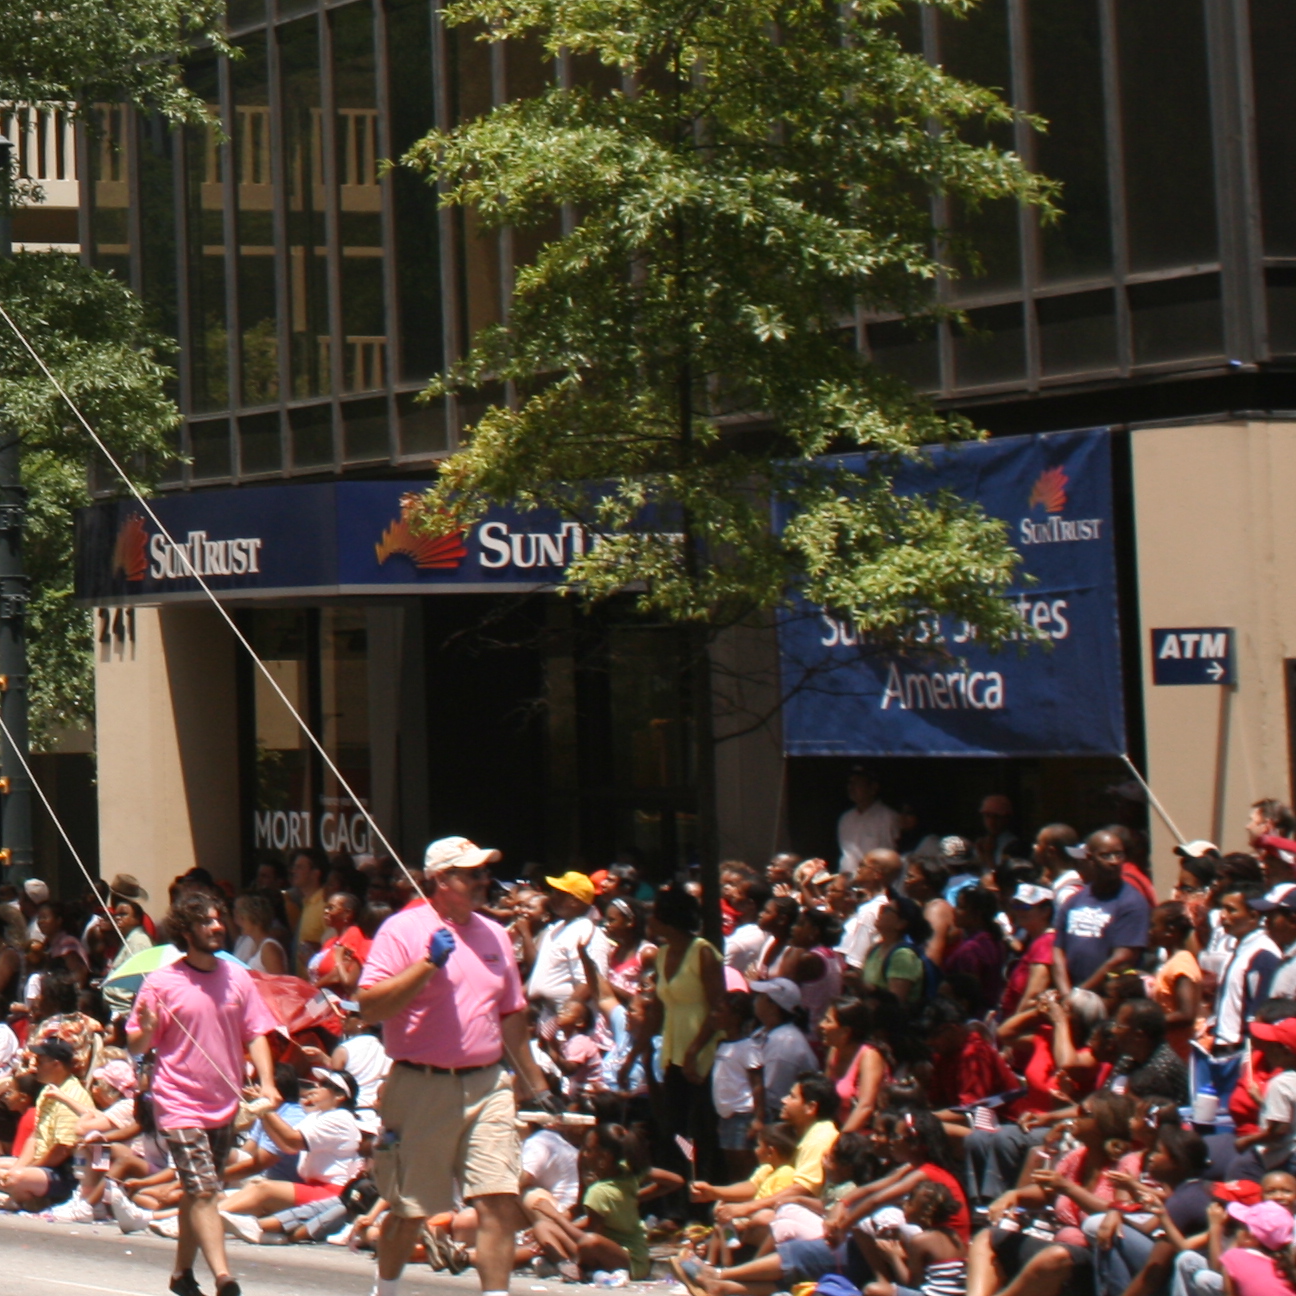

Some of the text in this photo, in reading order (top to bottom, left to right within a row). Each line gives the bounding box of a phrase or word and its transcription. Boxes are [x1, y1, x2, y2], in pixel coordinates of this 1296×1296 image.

[98, 607, 136, 643] 241
[1158, 633, 1228, 660] ATM
[880, 660, 1004, 710] America
